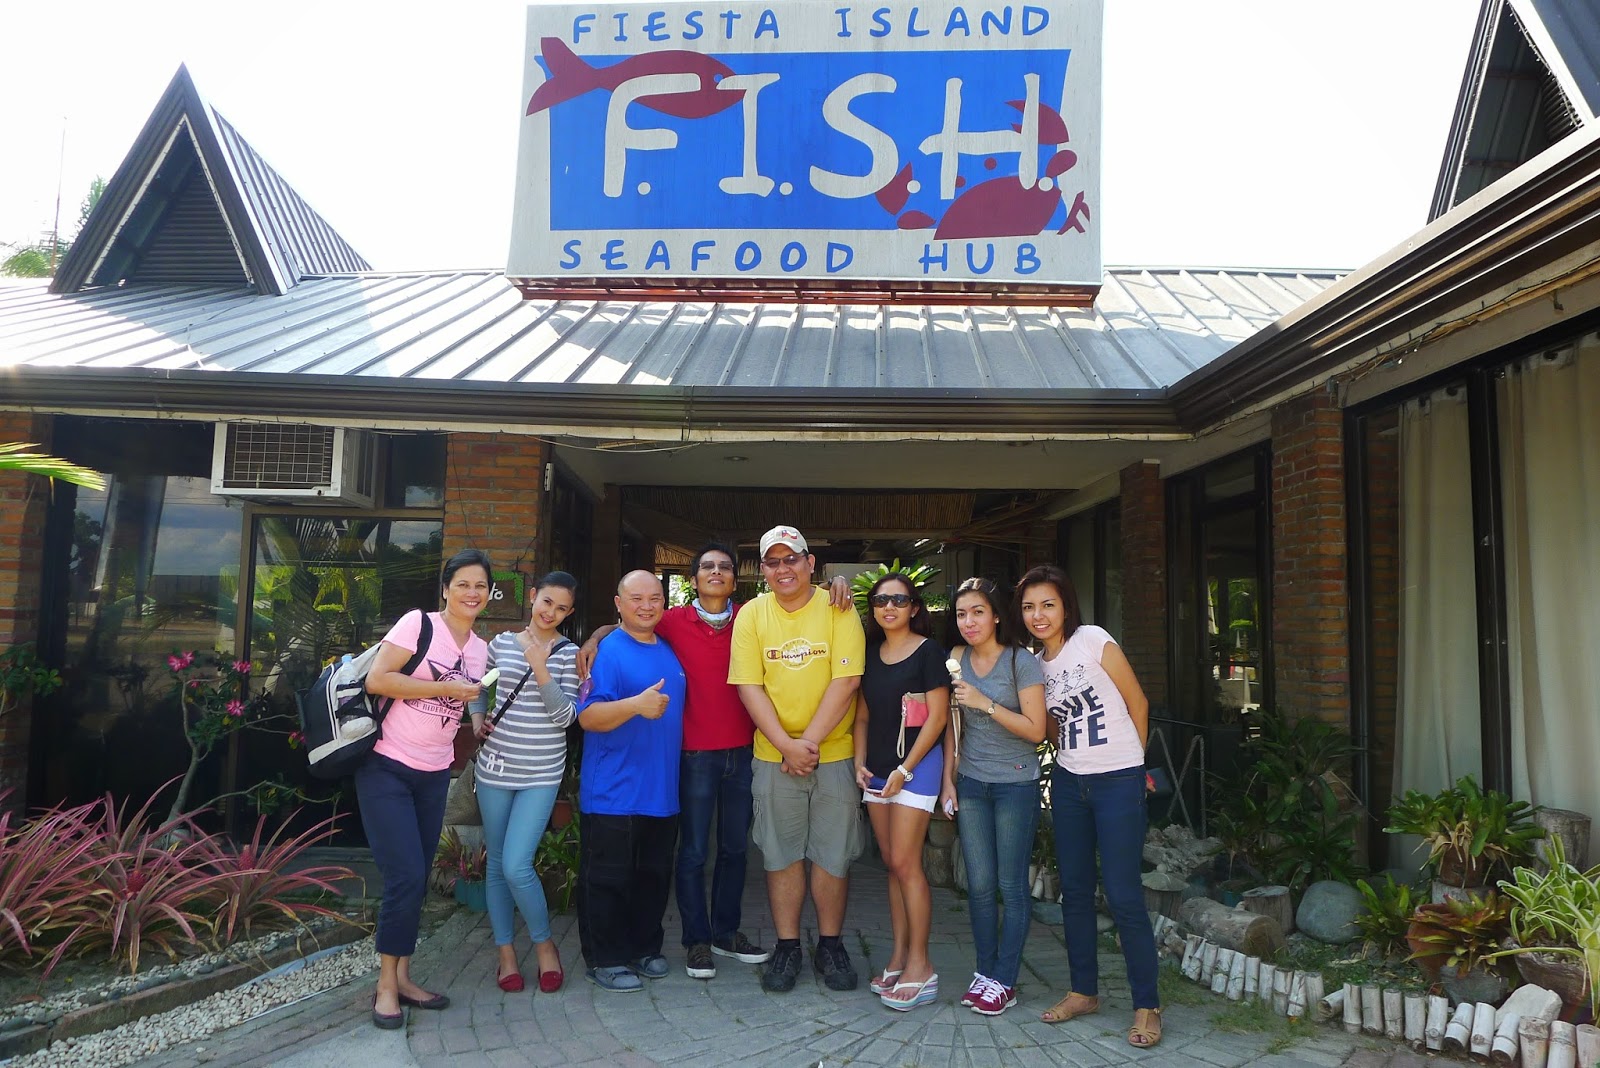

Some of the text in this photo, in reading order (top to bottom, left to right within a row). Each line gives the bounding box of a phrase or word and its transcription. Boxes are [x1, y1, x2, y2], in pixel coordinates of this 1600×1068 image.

[573, 5, 1050, 44] FIESTA ISLAND
[559, 239, 1041, 275] SEAFOOD HUB
[766, 648, 827, 661] Champion
[1049, 685, 1104, 723] OVE
[1058, 710, 1108, 751] IFE
